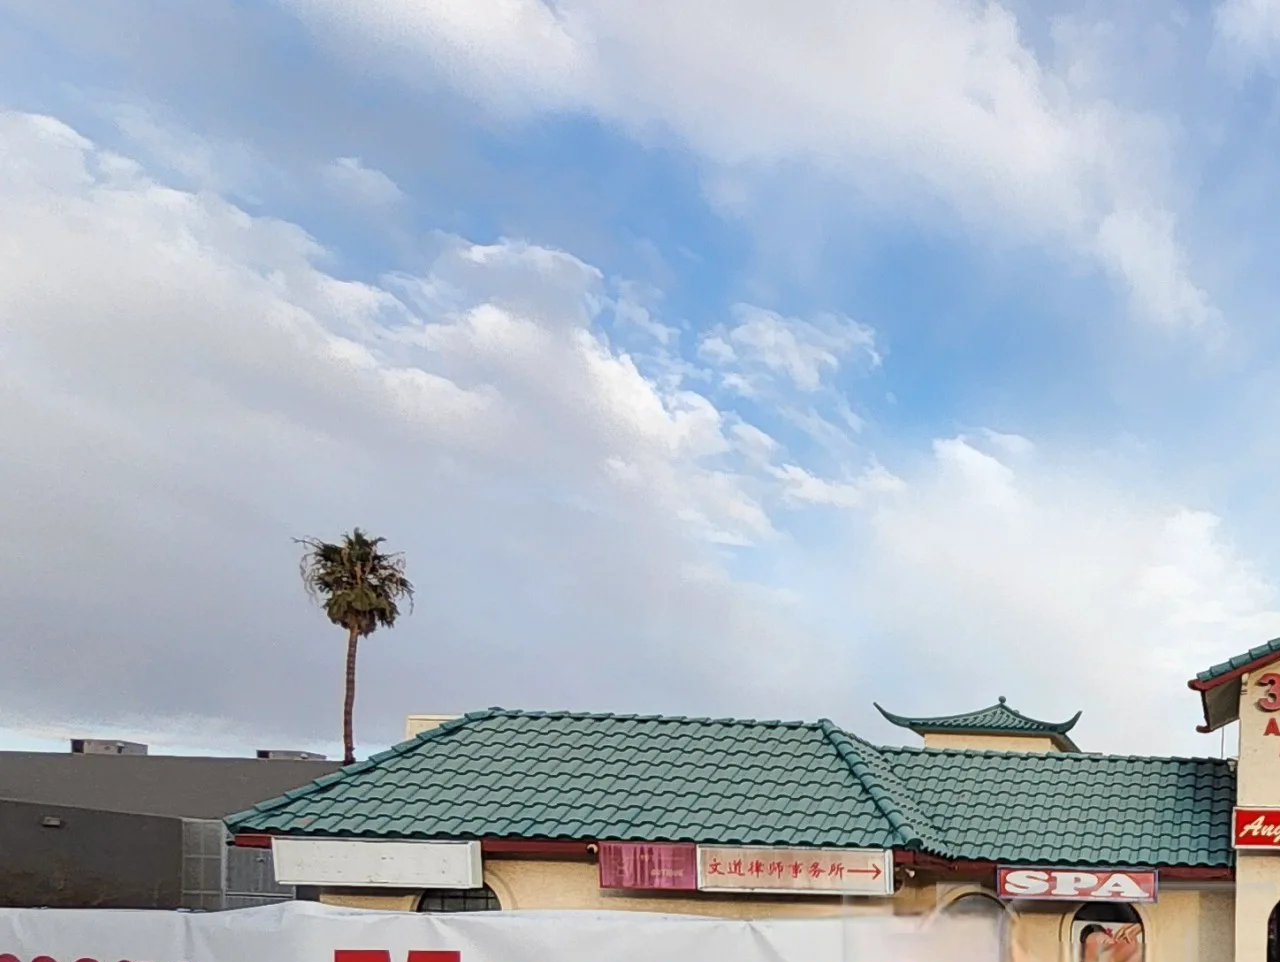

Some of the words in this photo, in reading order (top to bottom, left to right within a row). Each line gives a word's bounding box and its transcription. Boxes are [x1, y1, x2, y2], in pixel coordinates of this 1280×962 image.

[708, 857, 845, 878] 文道律师事务所
[1004, 870, 1150, 897] SPA
